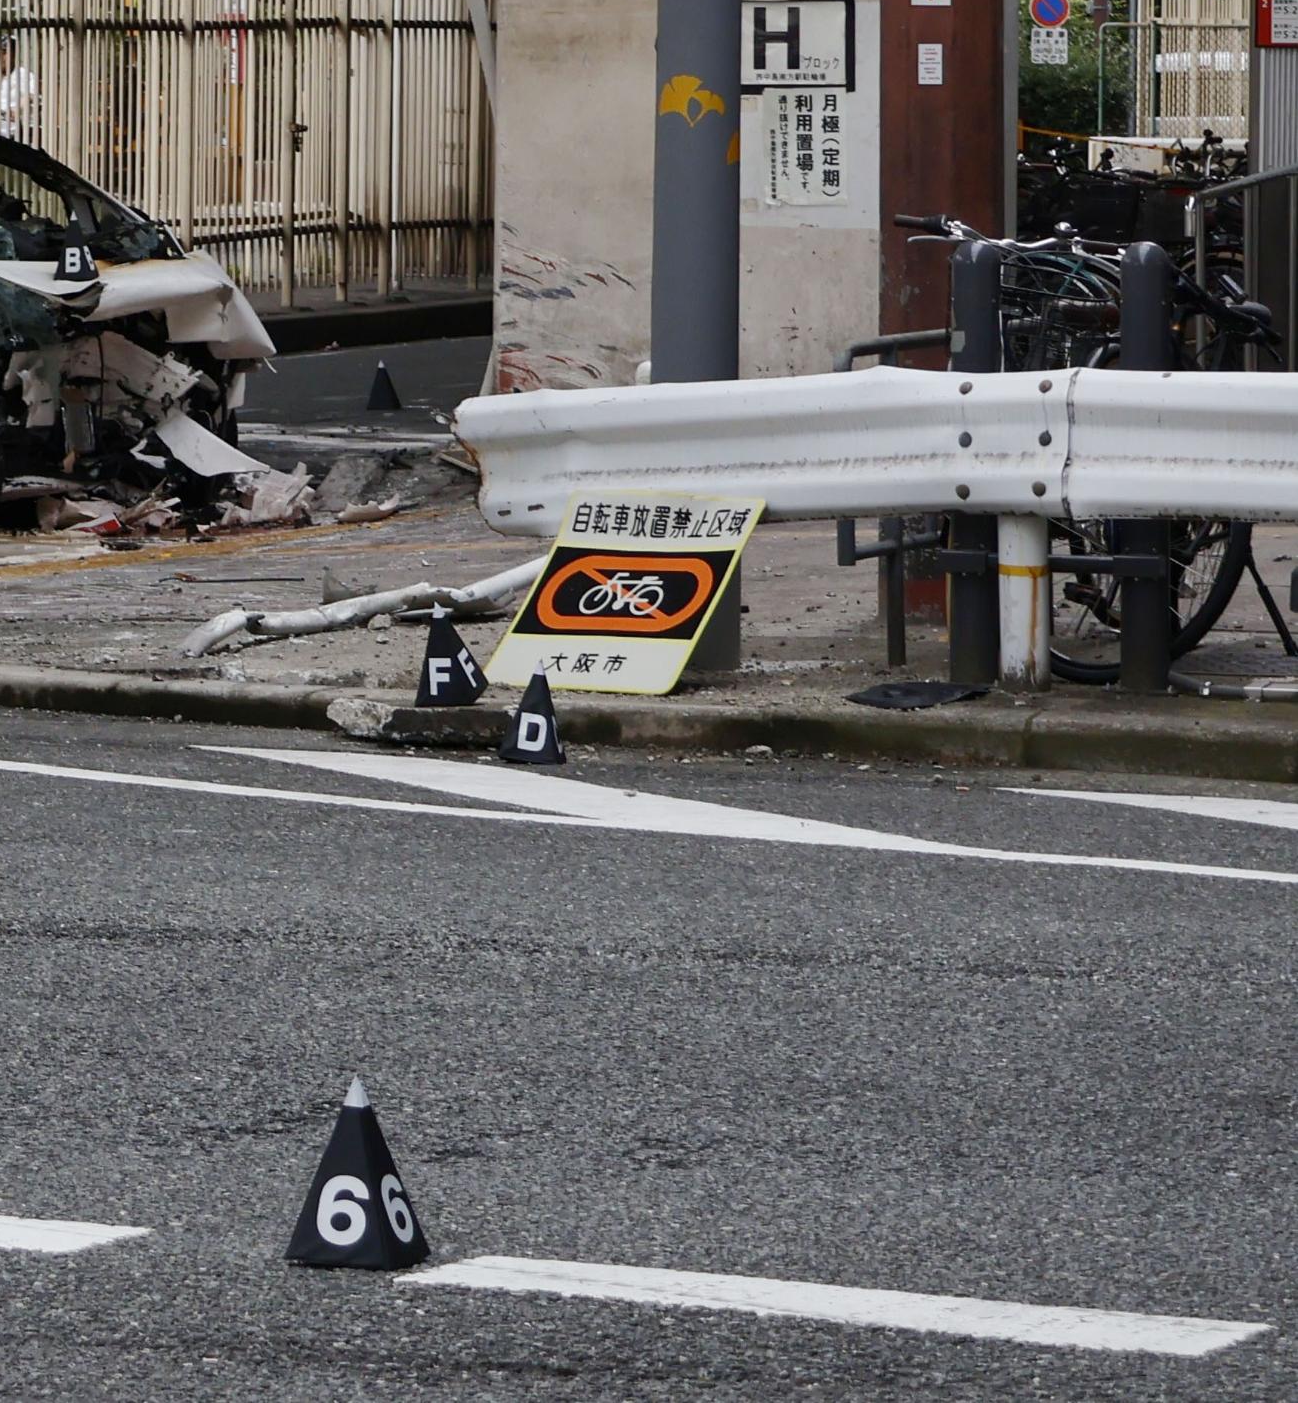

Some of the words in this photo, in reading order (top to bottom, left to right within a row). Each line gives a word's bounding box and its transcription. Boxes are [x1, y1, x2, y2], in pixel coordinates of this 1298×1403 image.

[753, 7, 800, 70] H
[803, 56, 840, 70] ブロック
[65, 247, 81, 273] B
[572, 501, 752, 539] 自転車放置禁止区域
[428, 657, 452, 696] F
[457, 647, 477, 689] F
[543, 652, 627, 674] 大阪市
[517, 711, 548, 752] D
[316, 1174, 370, 1246] 6
